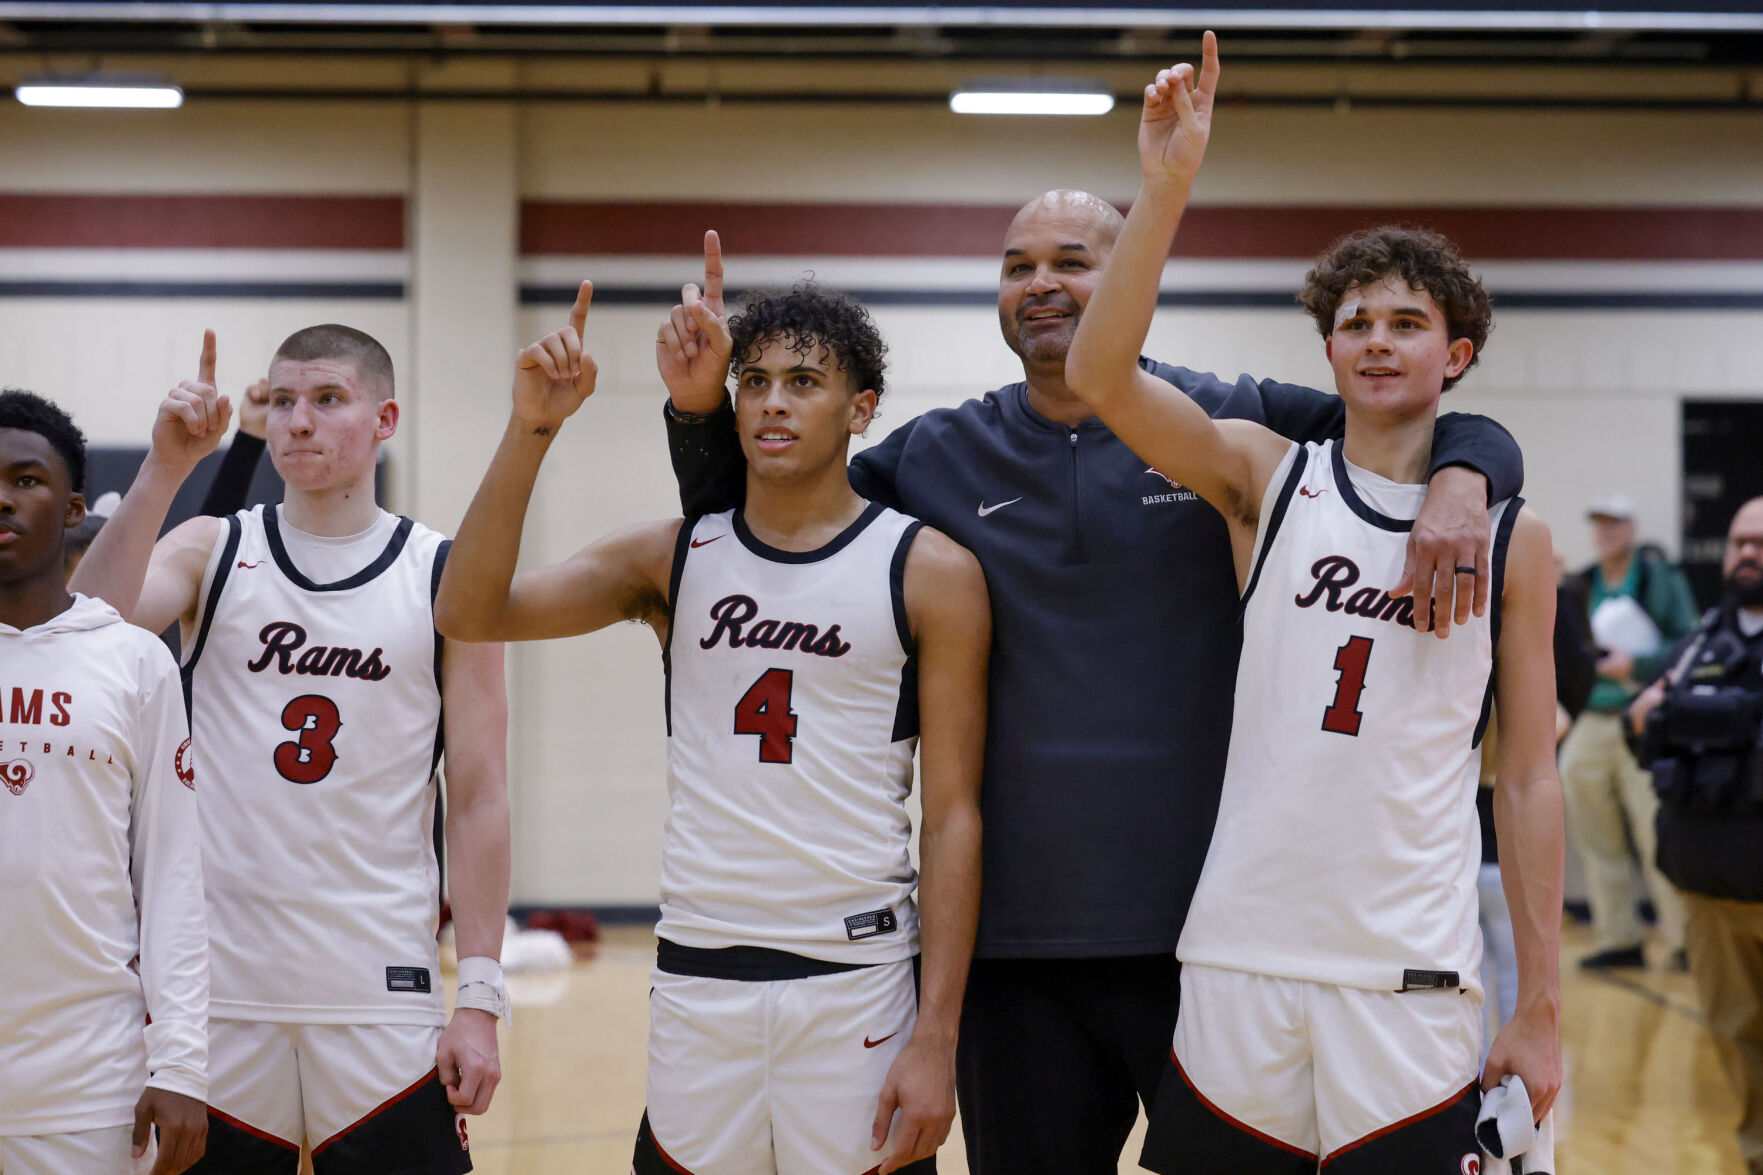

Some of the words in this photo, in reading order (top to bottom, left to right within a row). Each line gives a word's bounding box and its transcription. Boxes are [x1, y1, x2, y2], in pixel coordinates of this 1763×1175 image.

[1142, 491, 1198, 505] BASKETBALL
[247, 621, 391, 681] Rams
[699, 594, 852, 658] Rams
[0, 686, 72, 727] MS
[1321, 634, 1375, 737] 1
[273, 694, 344, 785] 3
[733, 667, 798, 765] 4
[883, 916, 891, 927] S
[420, 975, 425, 985] L
